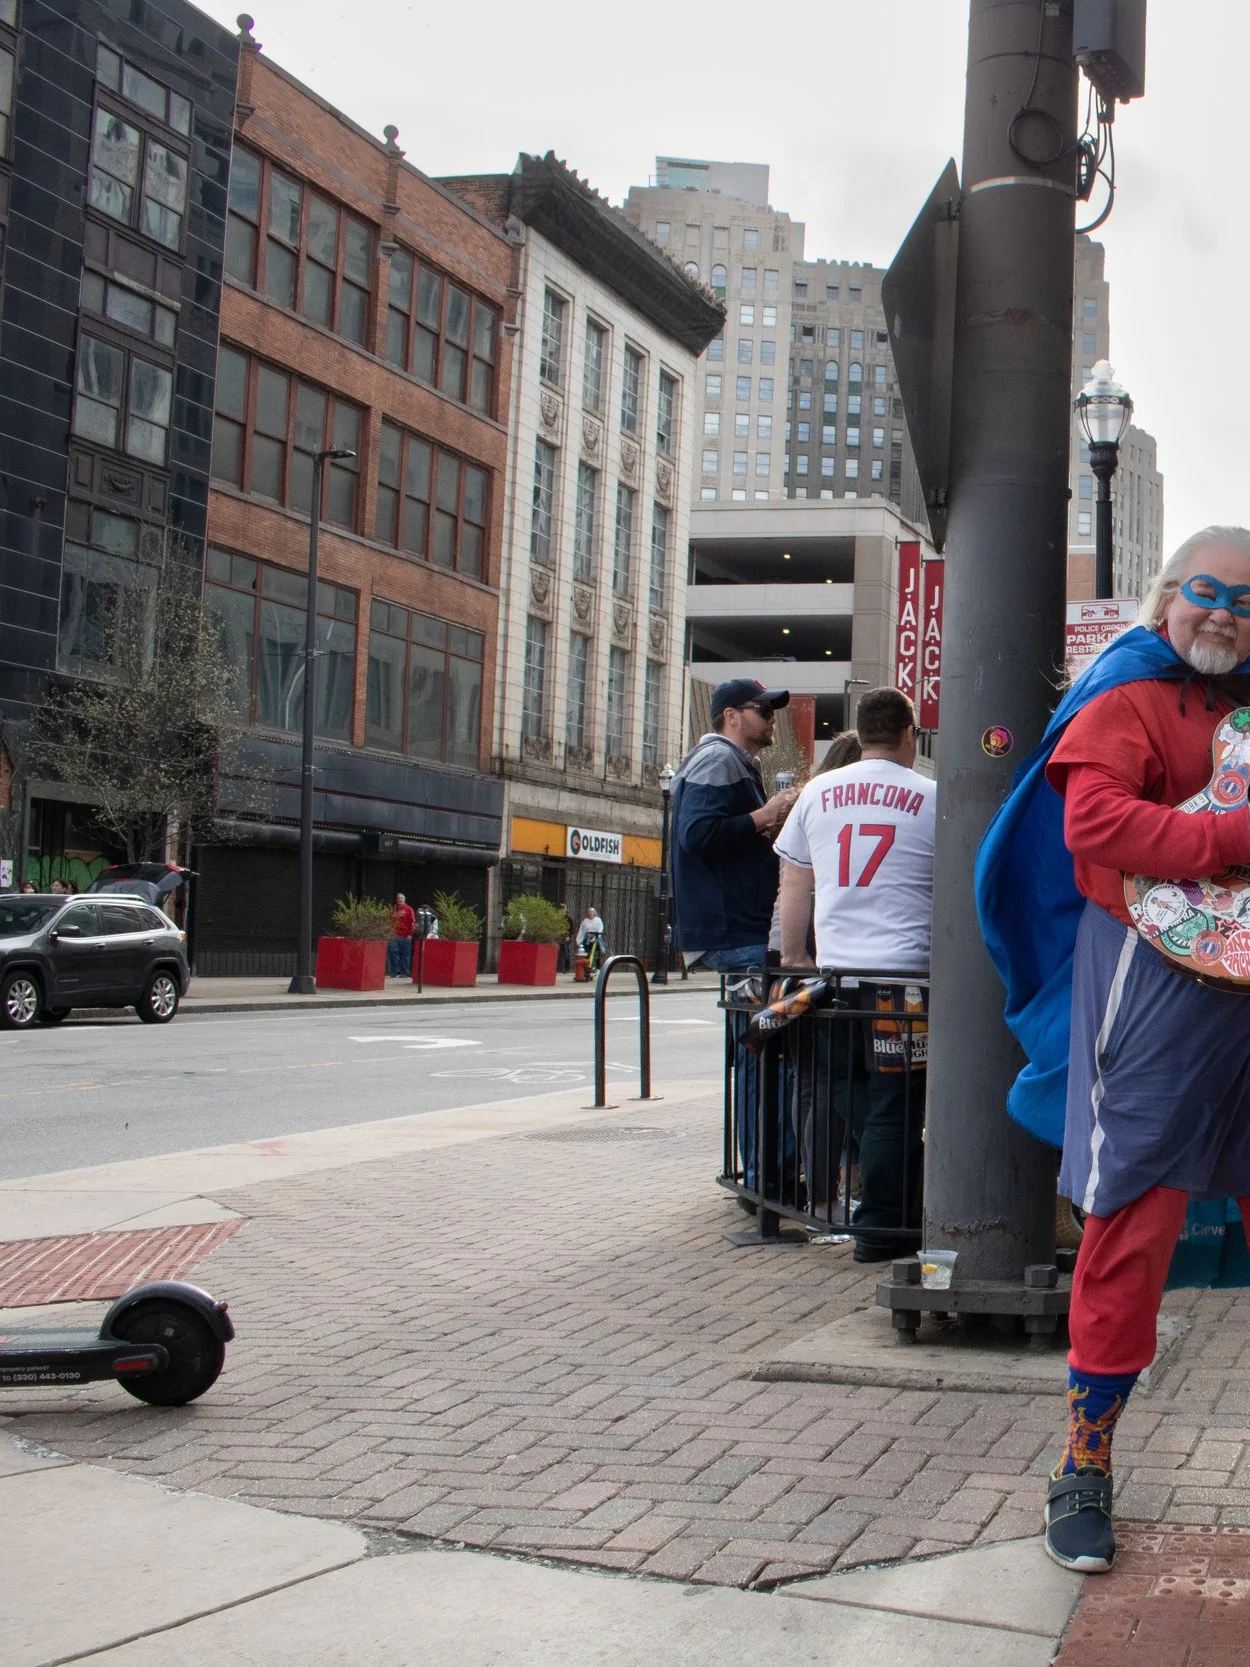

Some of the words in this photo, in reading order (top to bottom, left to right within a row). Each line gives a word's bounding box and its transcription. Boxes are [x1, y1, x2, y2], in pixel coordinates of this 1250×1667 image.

[898, 568, 918, 689] JACK
[923, 585, 940, 701] JACK
[1066, 633, 1115, 645] PARKI
[1074, 625, 1100, 633] POLICE
[821, 782, 925, 816] FRANCONA
[571, 829, 620, 856] GOLDFISH
[837, 823, 896, 888] 17
[873, 1038, 905, 1054] Blue
